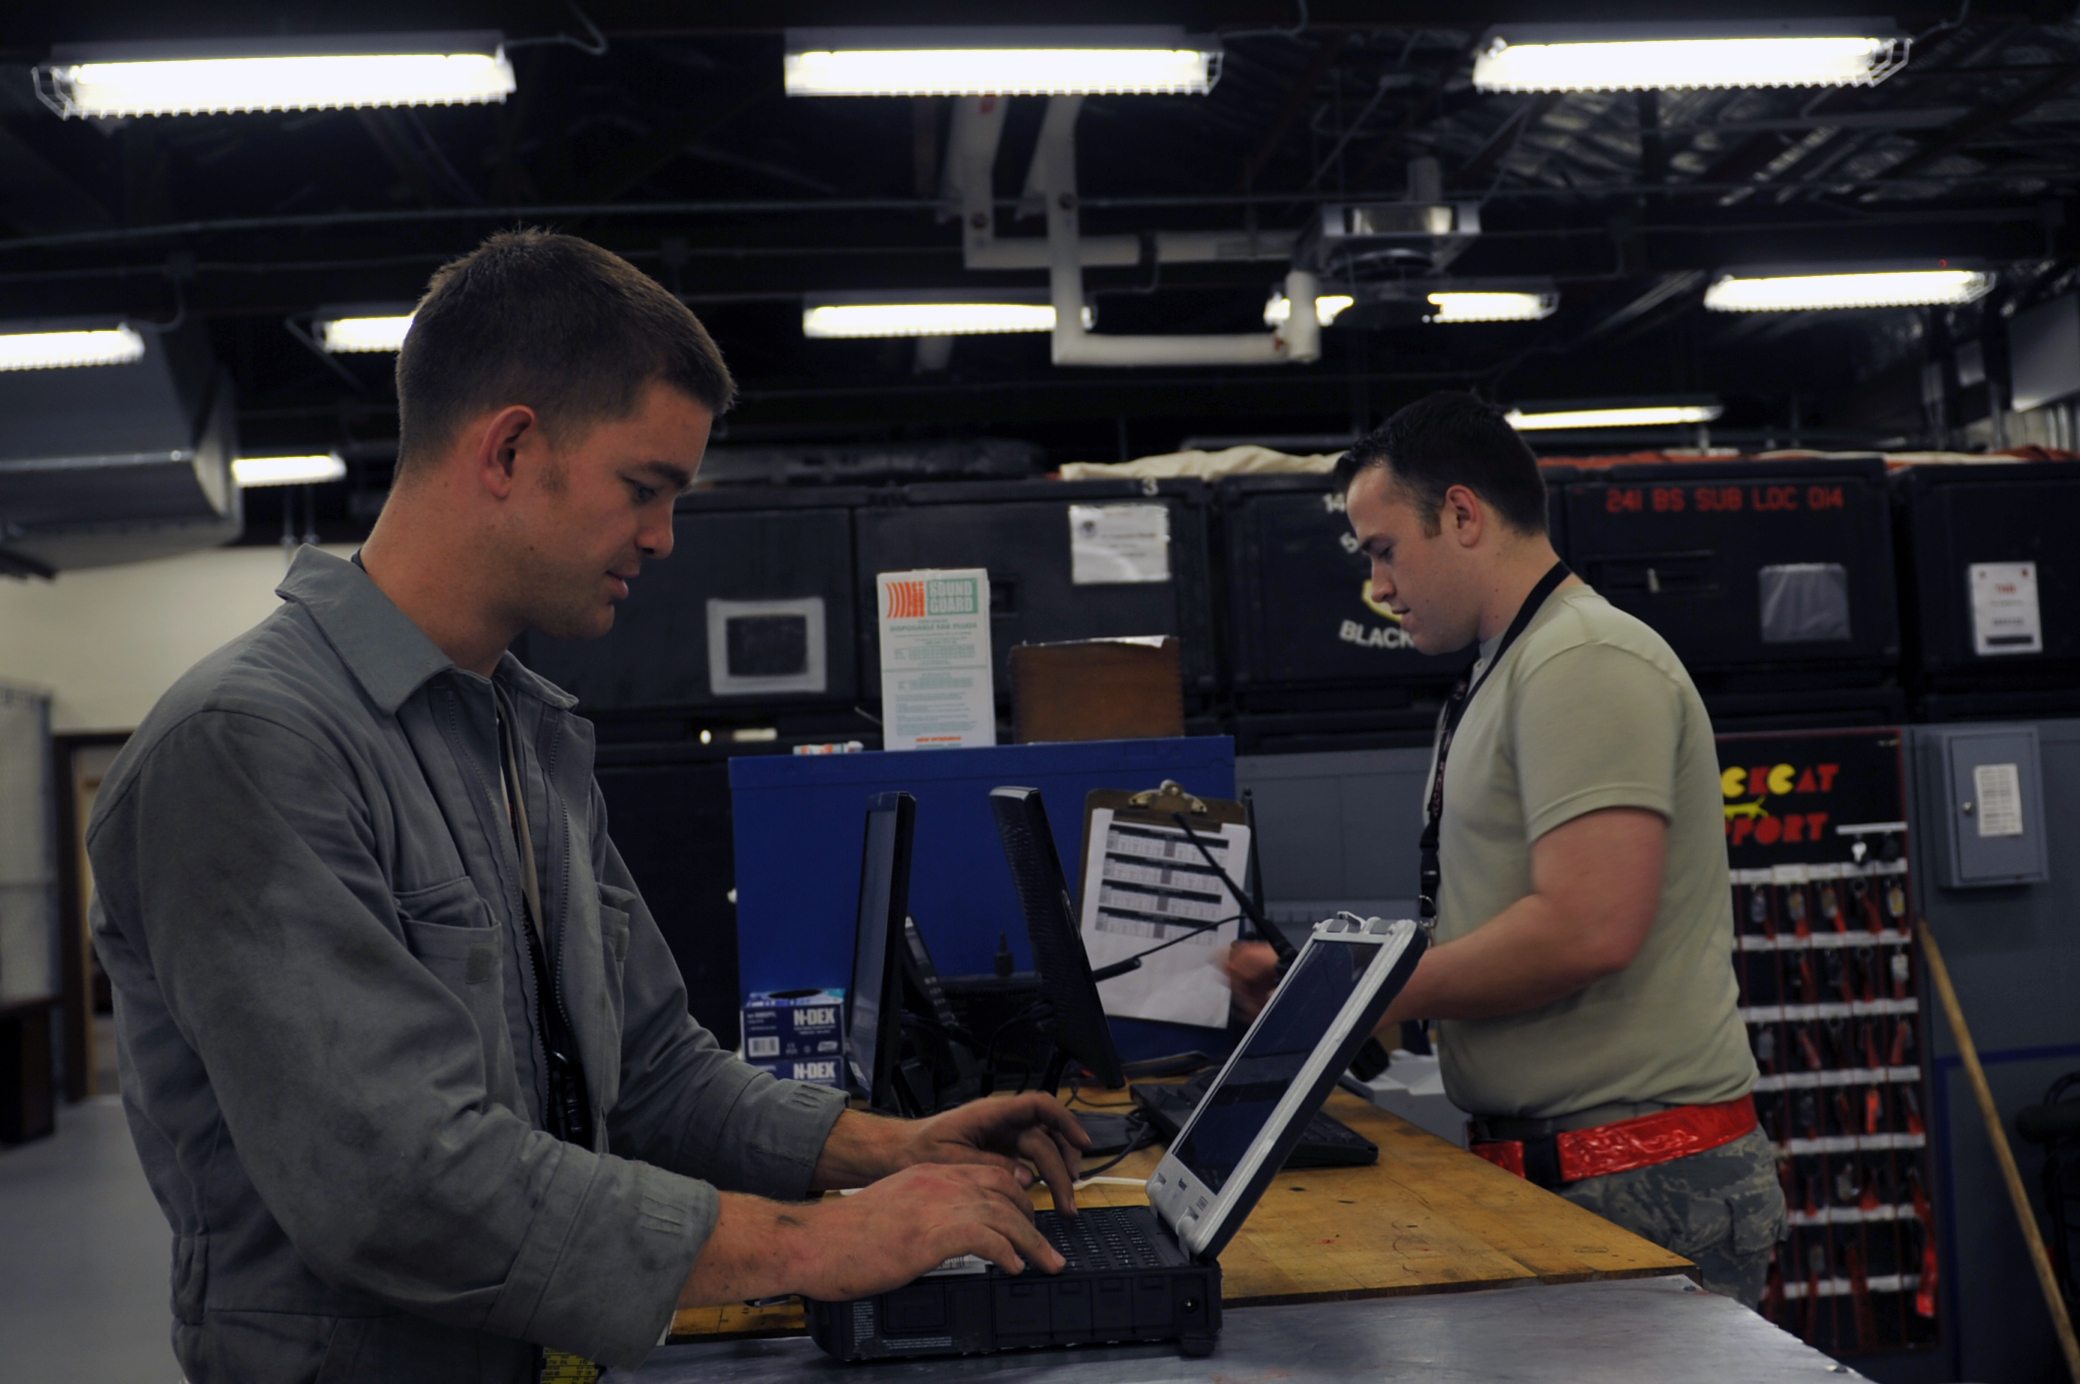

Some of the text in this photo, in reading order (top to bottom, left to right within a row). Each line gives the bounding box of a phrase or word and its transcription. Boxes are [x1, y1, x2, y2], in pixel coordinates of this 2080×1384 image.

[1142, 476, 1159, 496] 3
[1605, 488, 1643, 512] 241
[1653, 487, 1685, 511] BS
[1695, 486, 1743, 511] SUB
[1753, 486, 1798, 511] LOC
[929, 580, 973, 597] SOUND
[930, 597, 974, 613] GUARD
[1338, 619, 1416, 648] BLACK
[793, 1007, 835, 1026] N-DEX
[793, 1061, 836, 1080] N-DEX
